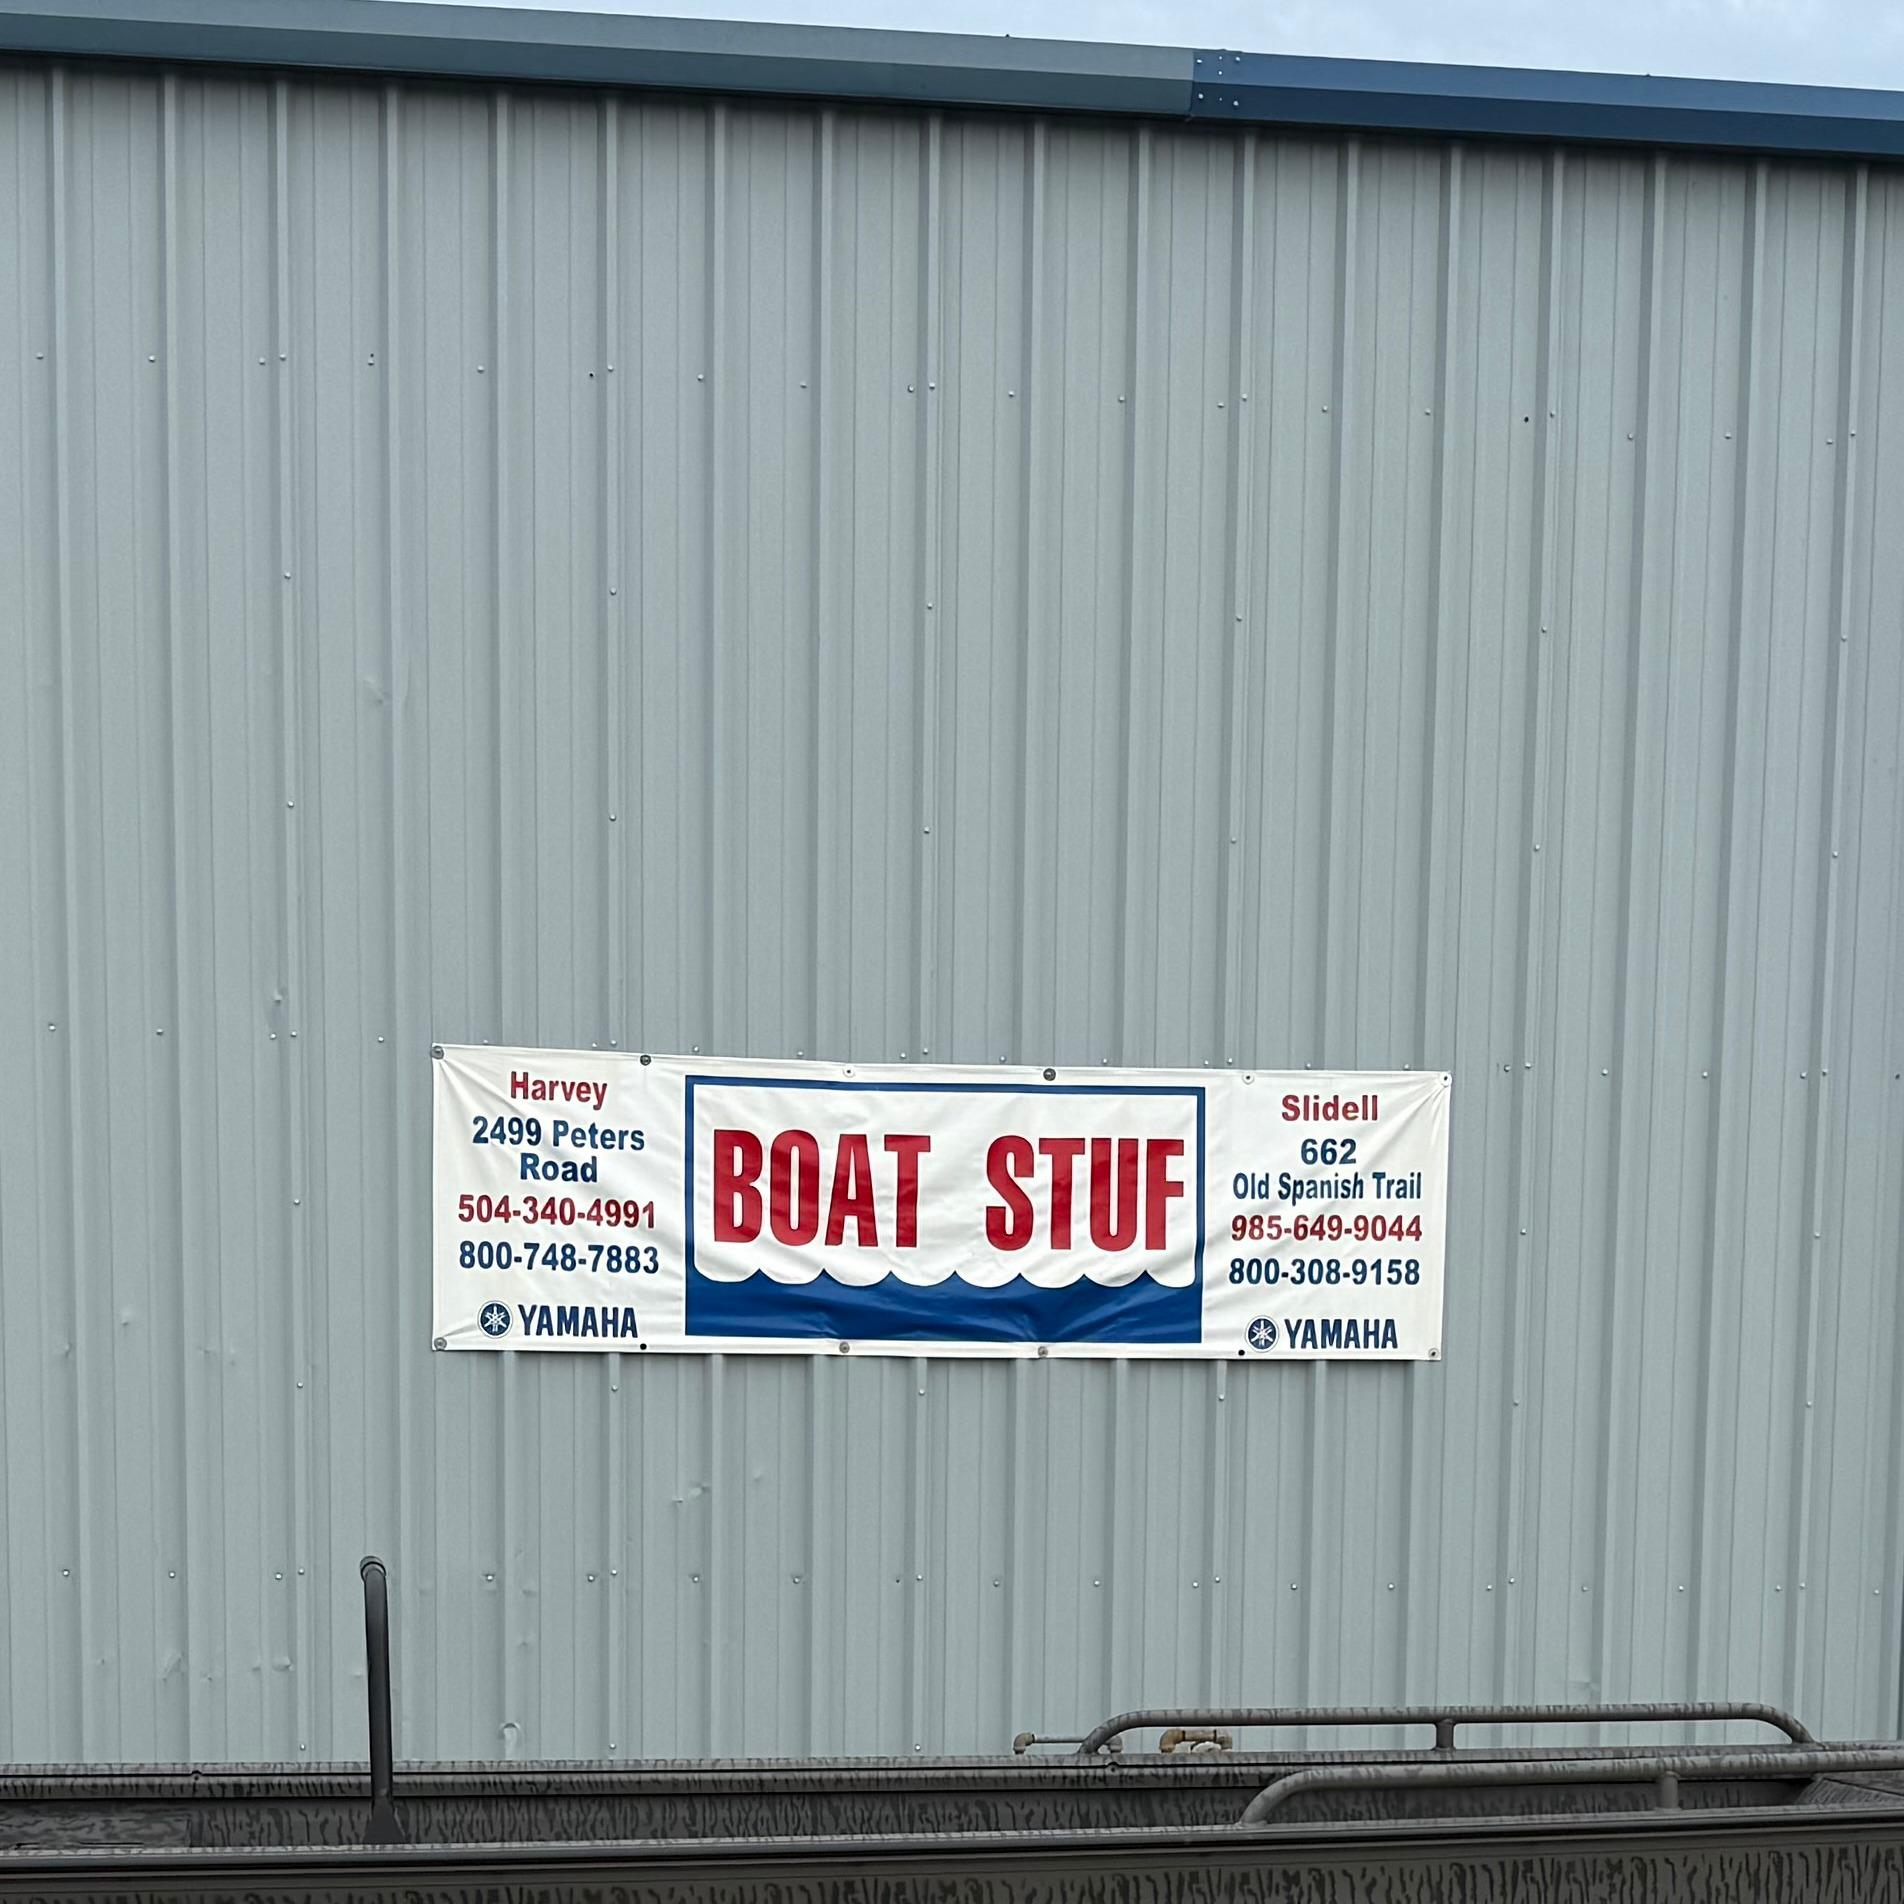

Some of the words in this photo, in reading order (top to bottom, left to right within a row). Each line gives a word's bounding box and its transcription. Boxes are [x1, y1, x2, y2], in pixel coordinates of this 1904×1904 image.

[510, 1070, 608, 1111] Harvey
[1281, 1094, 1379, 1122] Slidell
[472, 1115, 542, 1146] 2499
[552, 1119, 645, 1151] Peters
[519, 1152, 598, 1183] Road
[1300, 1138, 1357, 1166] 662
[713, 1129, 931, 1248] BOAT
[985, 1135, 1185, 1252] STUF
[1232, 1172, 1270, 1200] Old
[1277, 1171, 1364, 1207] Spanish
[1372, 1171, 1422, 1200] Trail
[458, 1194, 655, 1229] 504-340-4991
[1231, 1214, 1423, 1242] 985-649-9044
[459, 1240, 659, 1274] 800-748-7883
[1228, 1257, 1420, 1286] 800-308-9158
[517, 1304, 638, 1338] YAMAHA
[1283, 1318, 1399, 1350] YAMAHA
